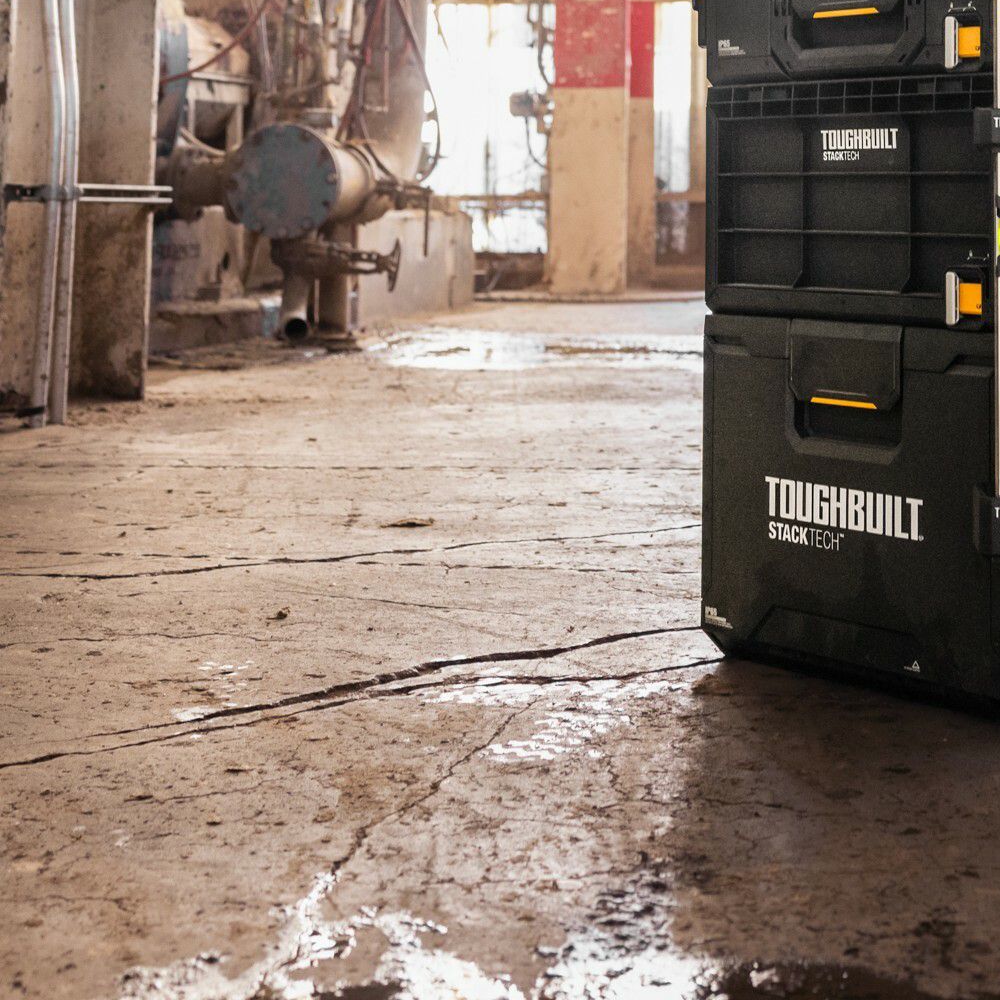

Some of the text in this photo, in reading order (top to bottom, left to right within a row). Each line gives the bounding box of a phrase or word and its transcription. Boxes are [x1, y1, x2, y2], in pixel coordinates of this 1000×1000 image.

[821, 128, 898, 150] TOUGHBUILT
[823, 151, 860, 161] STACKTECH
[765, 476, 924, 541] TOUGHBUILT
[768, 521, 841, 551] STACKTECH
